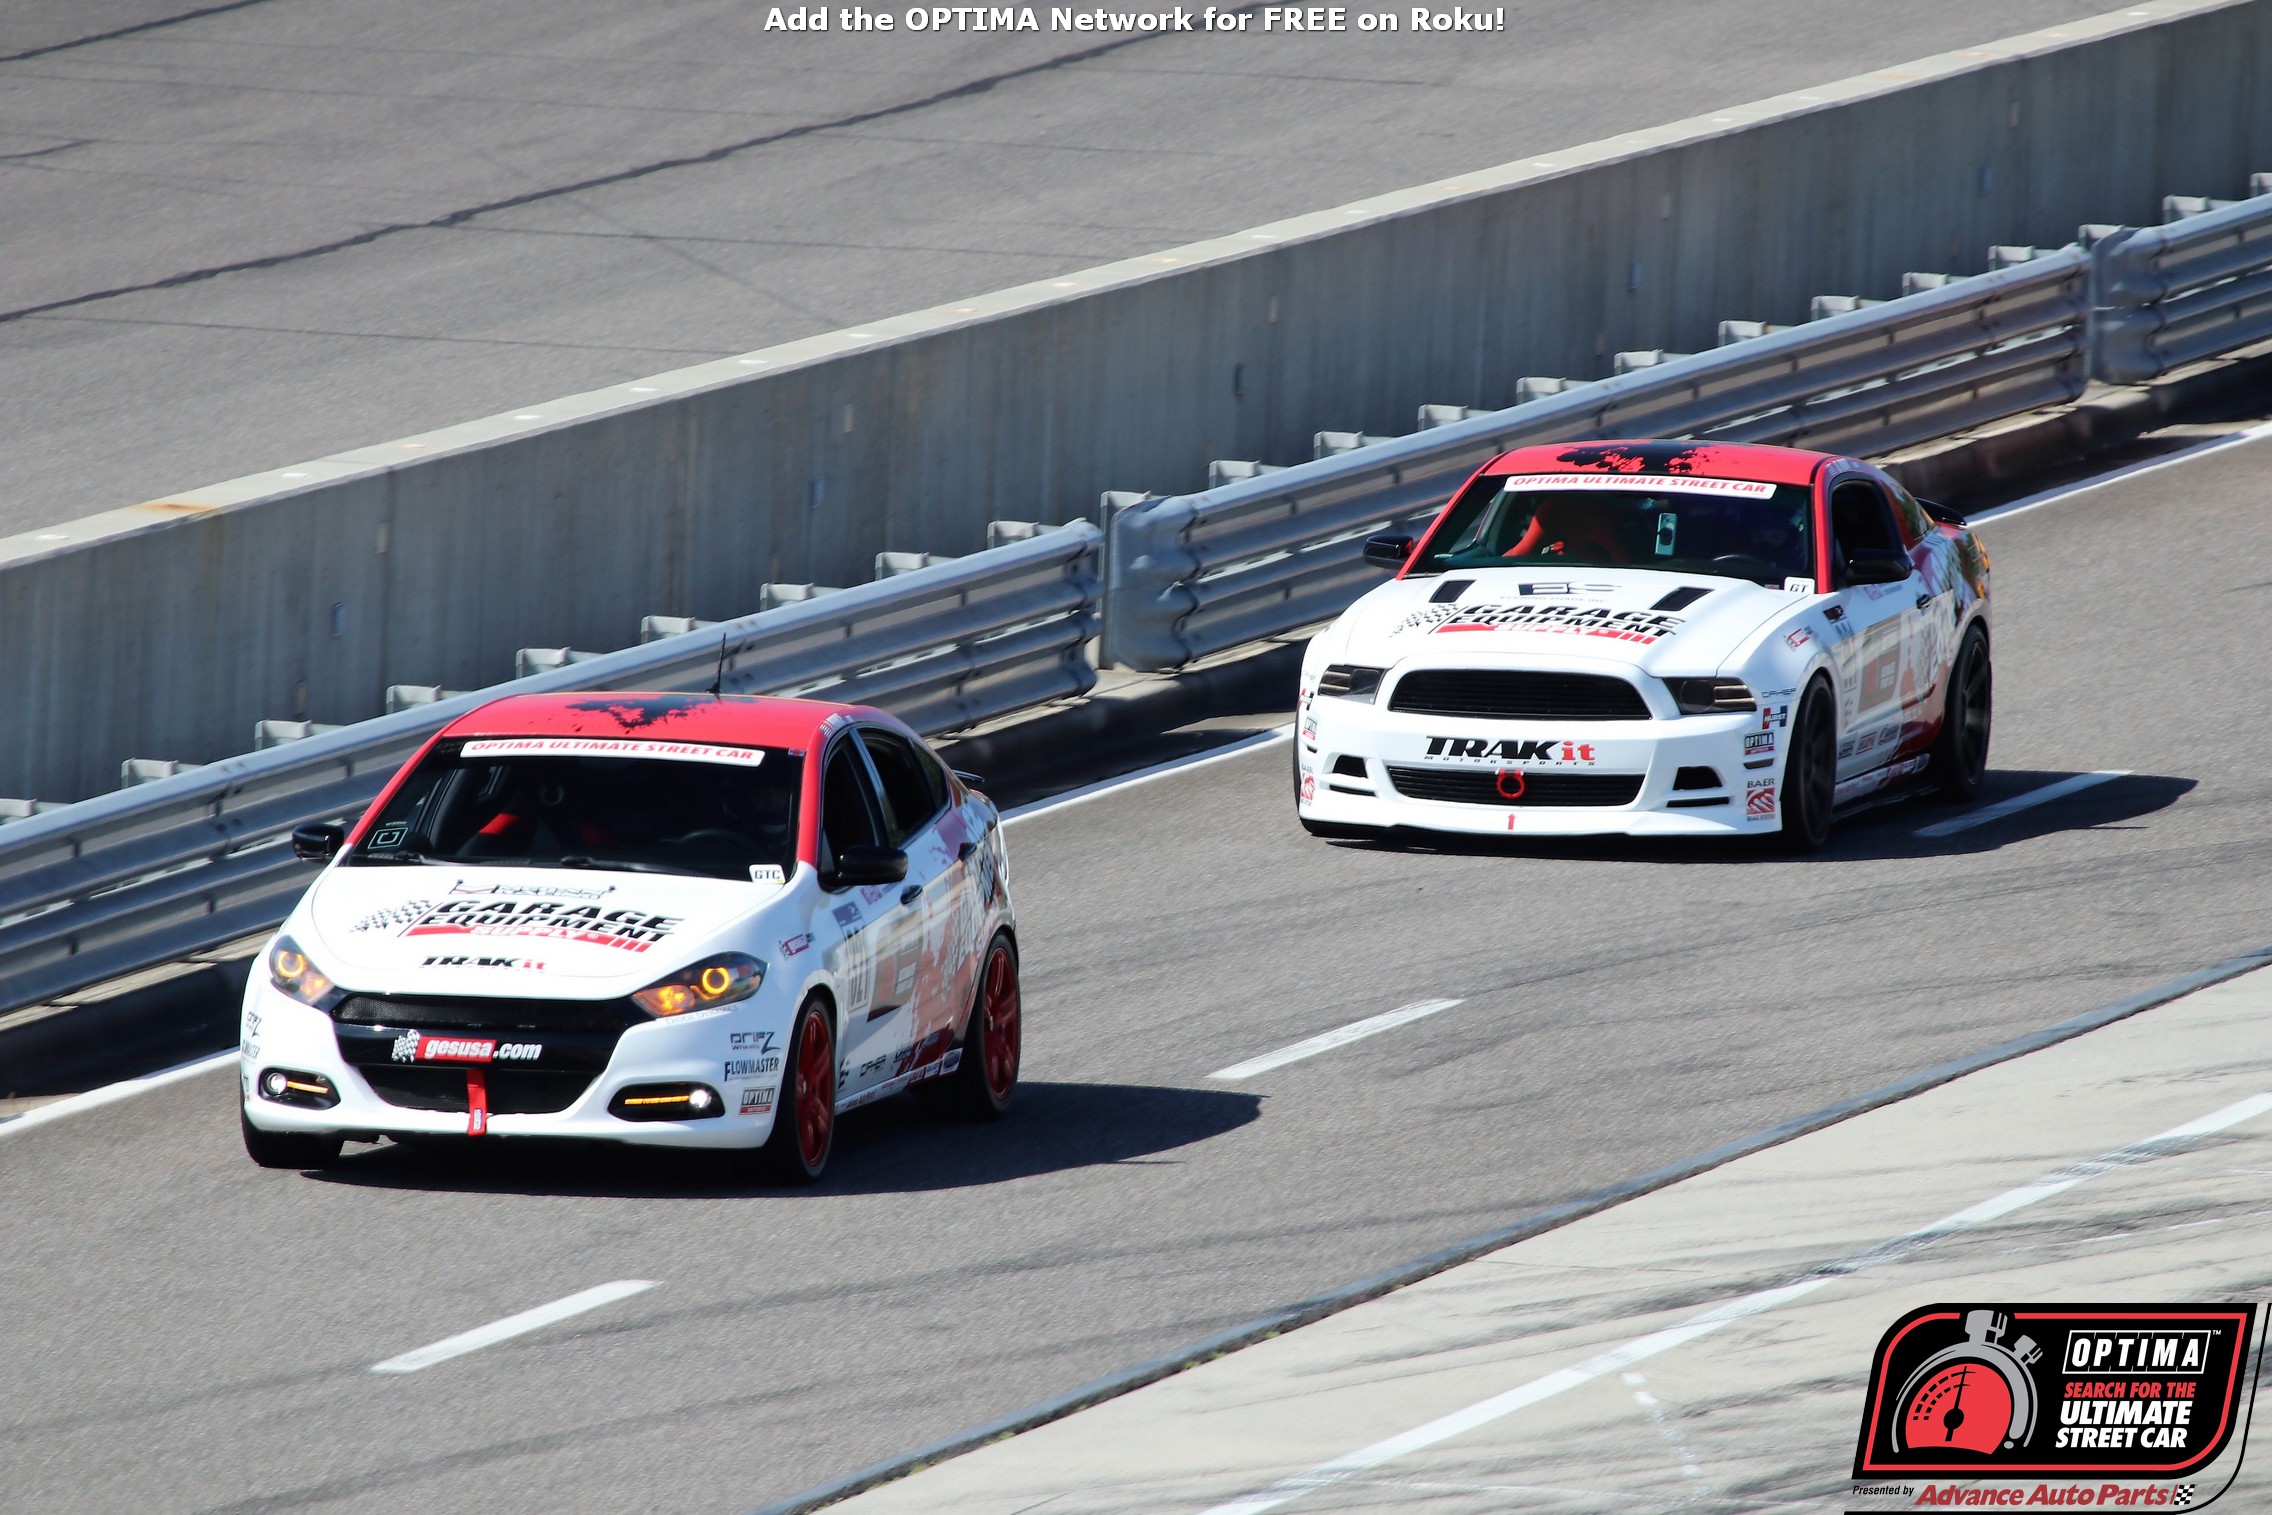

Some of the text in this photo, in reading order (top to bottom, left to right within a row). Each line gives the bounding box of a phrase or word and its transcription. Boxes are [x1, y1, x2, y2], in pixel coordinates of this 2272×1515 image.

[1513, 475, 1767, 494] OPTIMA ULTIMATE STREET CAR
[1789, 584, 1809, 593] GT
[1462, 604, 1686, 626] GARAGE
[1447, 614, 1678, 637] EQUIPMENT
[1745, 732, 1774, 748] OPTIMA
[471, 740, 755, 760] OPTIMA ULTIMATE STREET CAR
[1424, 755, 1596, 766] MOTORSPORTS
[1747, 778, 1775, 789] BAER
[754, 869, 781, 880] GTC
[438, 900, 686, 931] GARAGE
[419, 913, 677, 942] EQUIPMENT
[424, 1039, 542, 1061] gesusa.com
[724, 1057, 780, 1082] FLOWMASTER
[743, 1089, 774, 1105] OPTIMA
